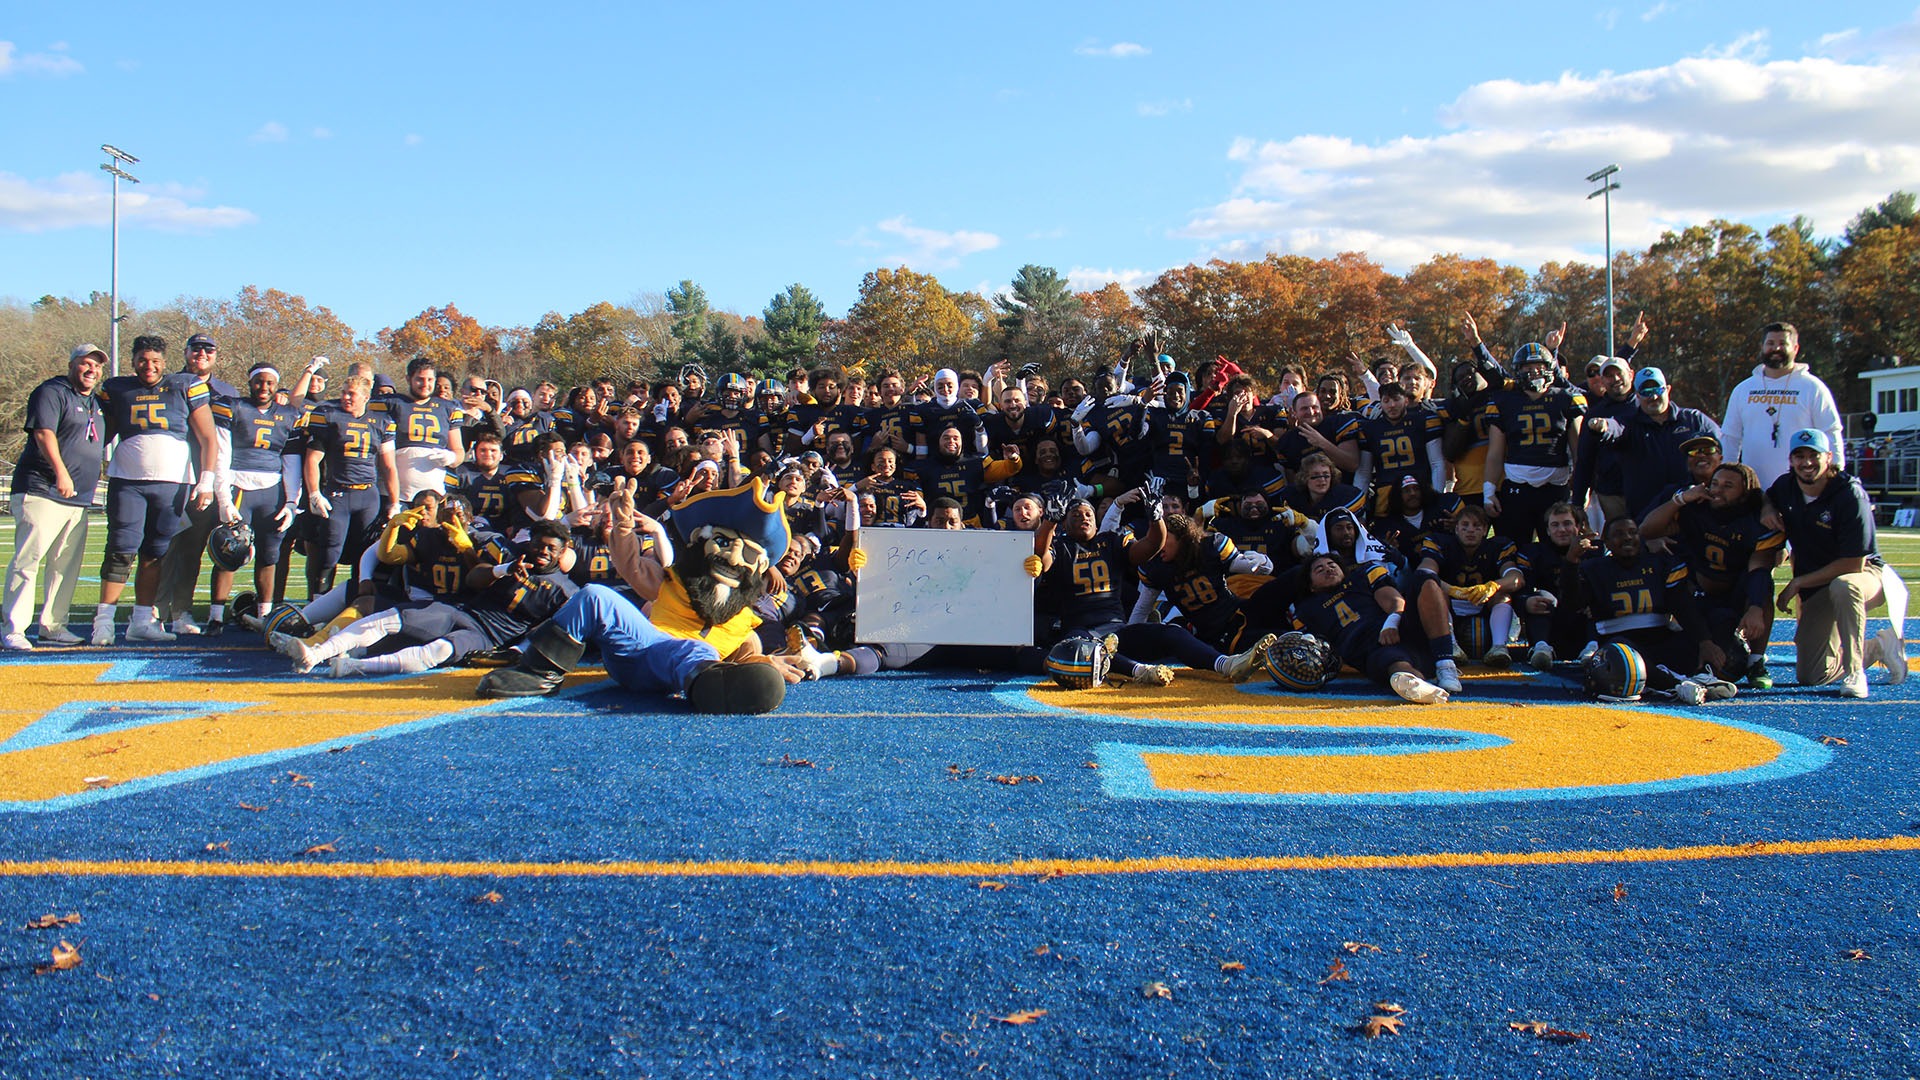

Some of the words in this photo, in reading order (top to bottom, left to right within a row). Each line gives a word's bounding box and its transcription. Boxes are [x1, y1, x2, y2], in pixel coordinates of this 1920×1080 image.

[1747, 395, 1798, 405] FOOTBALL
[130, 403, 169, 430] 55
[408, 413, 441, 444] 62
[1517, 412, 1553, 446] 32
[254, 427, 272, 449] 6
[344, 429, 371, 459] 21
[1168, 431, 1184, 456] 2
[1380, 435, 1415, 469] 29
[478, 492, 504, 518] 73
[1705, 544, 1727, 572] 9
[432, 563, 461, 594] 97
[1073, 559, 1112, 597] 58
[506, 586, 528, 613] 1
[1174, 575, 1218, 612] 28
[1334, 600, 1361, 628] 4
